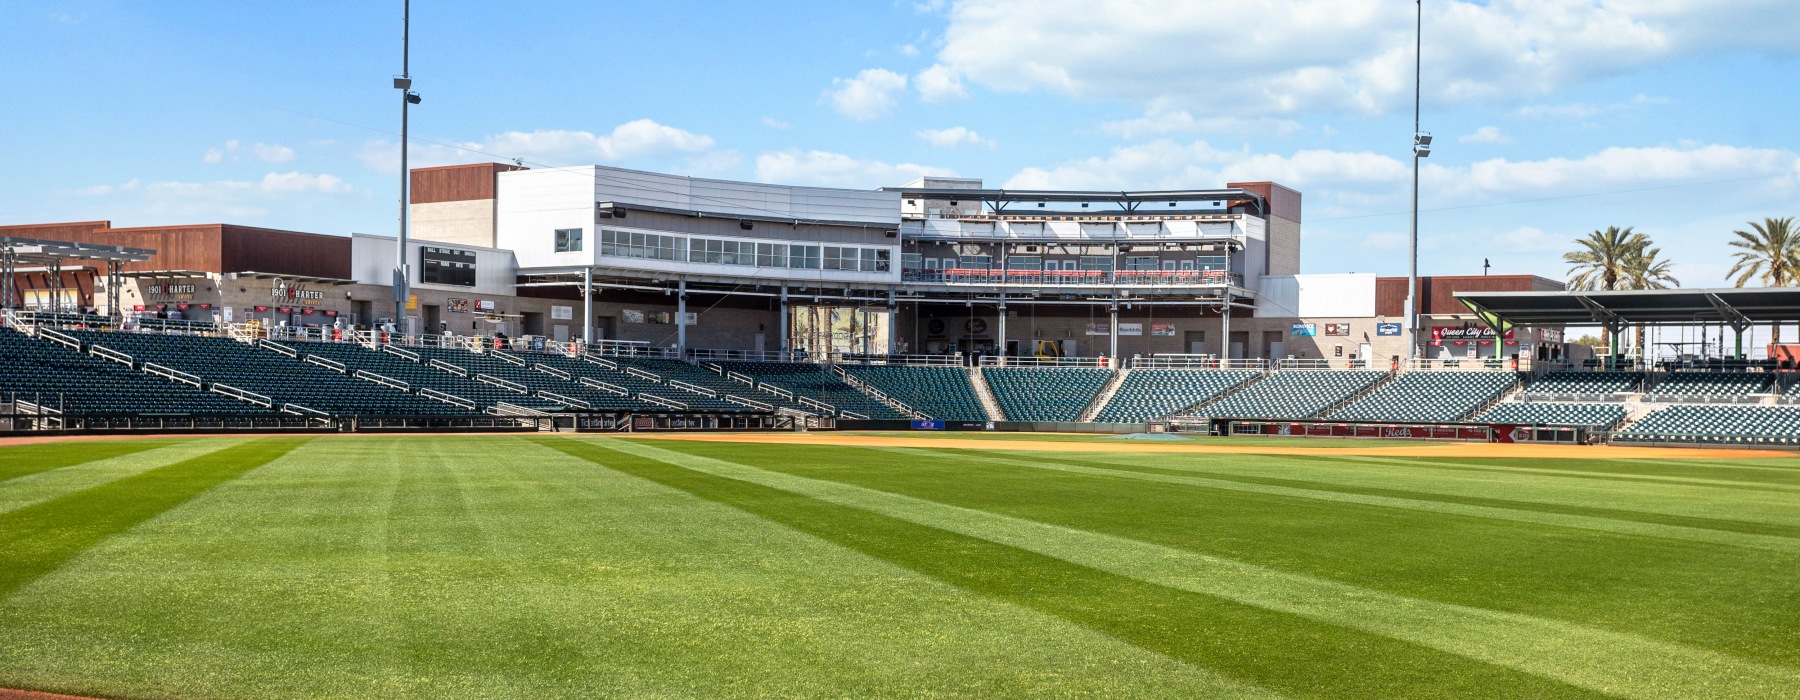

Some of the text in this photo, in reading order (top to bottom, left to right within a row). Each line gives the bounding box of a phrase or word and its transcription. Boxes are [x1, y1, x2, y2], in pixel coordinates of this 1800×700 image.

[148, 283, 195, 296] 1901 CHARTER
[272, 288, 323, 300] 1901 CHARTER
[1440, 328, 1464, 336] Queen
[1466, 328, 1481, 338] City
